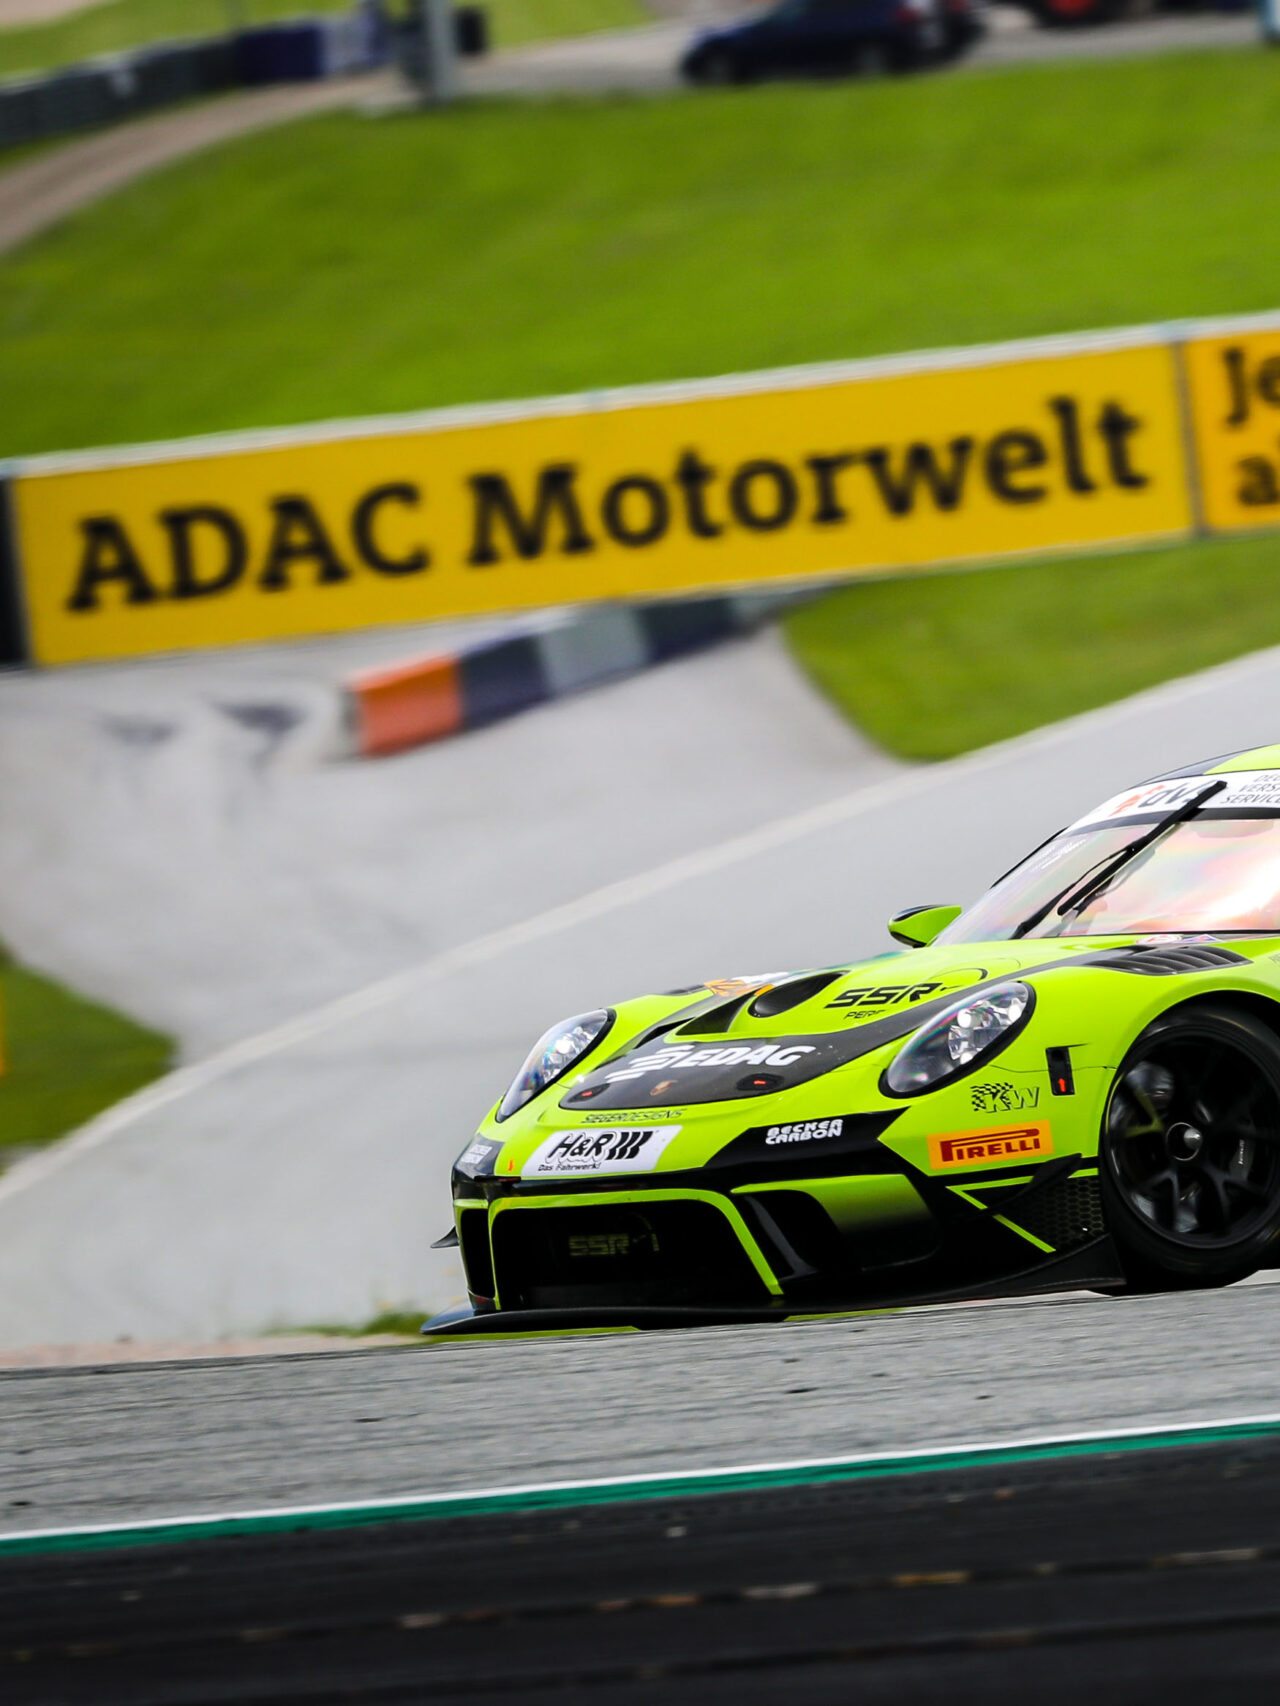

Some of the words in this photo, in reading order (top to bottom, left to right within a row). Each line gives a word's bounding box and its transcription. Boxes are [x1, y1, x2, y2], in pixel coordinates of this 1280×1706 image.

[67, 481, 430, 613] ADAC
[467, 397, 1150, 567] Motorwelt
[823, 982, 943, 1009] SSR
[686, 1045, 817, 1067] EDAG
[765, 1128, 842, 1145] CARBON
[767, 1119, 843, 1137] BECKER
[547, 1132, 614, 1160] H&R
[940, 1128, 1041, 1162] PIRELLI
